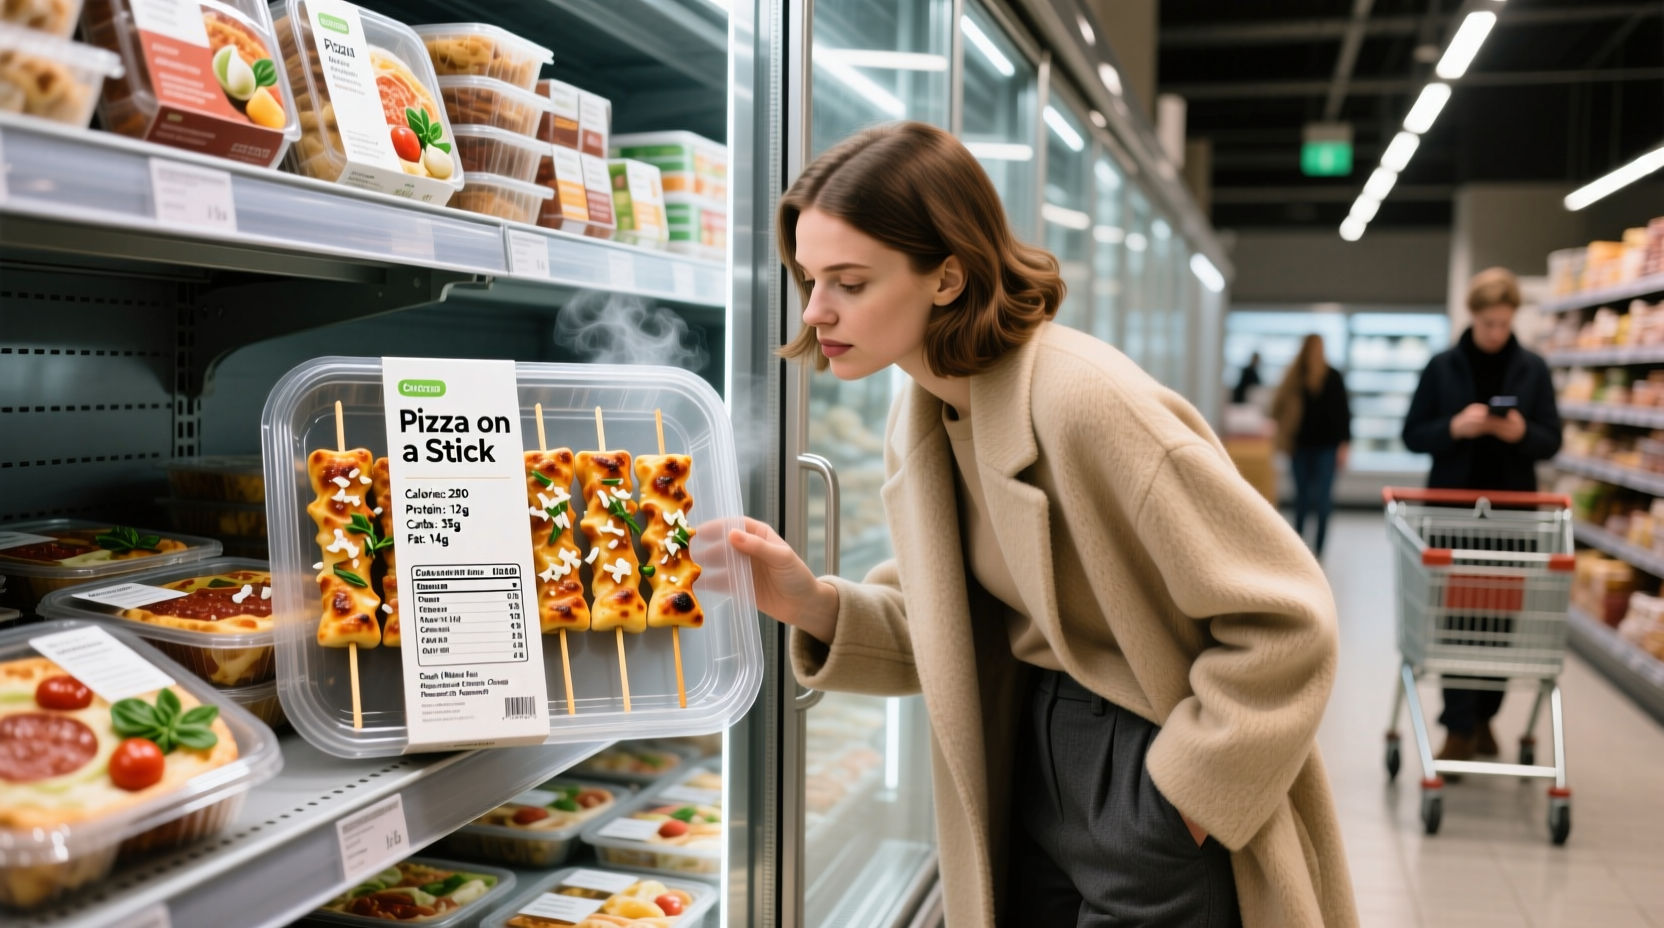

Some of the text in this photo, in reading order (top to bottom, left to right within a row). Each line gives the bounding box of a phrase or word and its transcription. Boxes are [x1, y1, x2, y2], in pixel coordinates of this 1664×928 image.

[400, 407, 510, 433] Pizza on
[402, 437, 496, 463] a Stick
[450, 504, 469, 517] 12g
